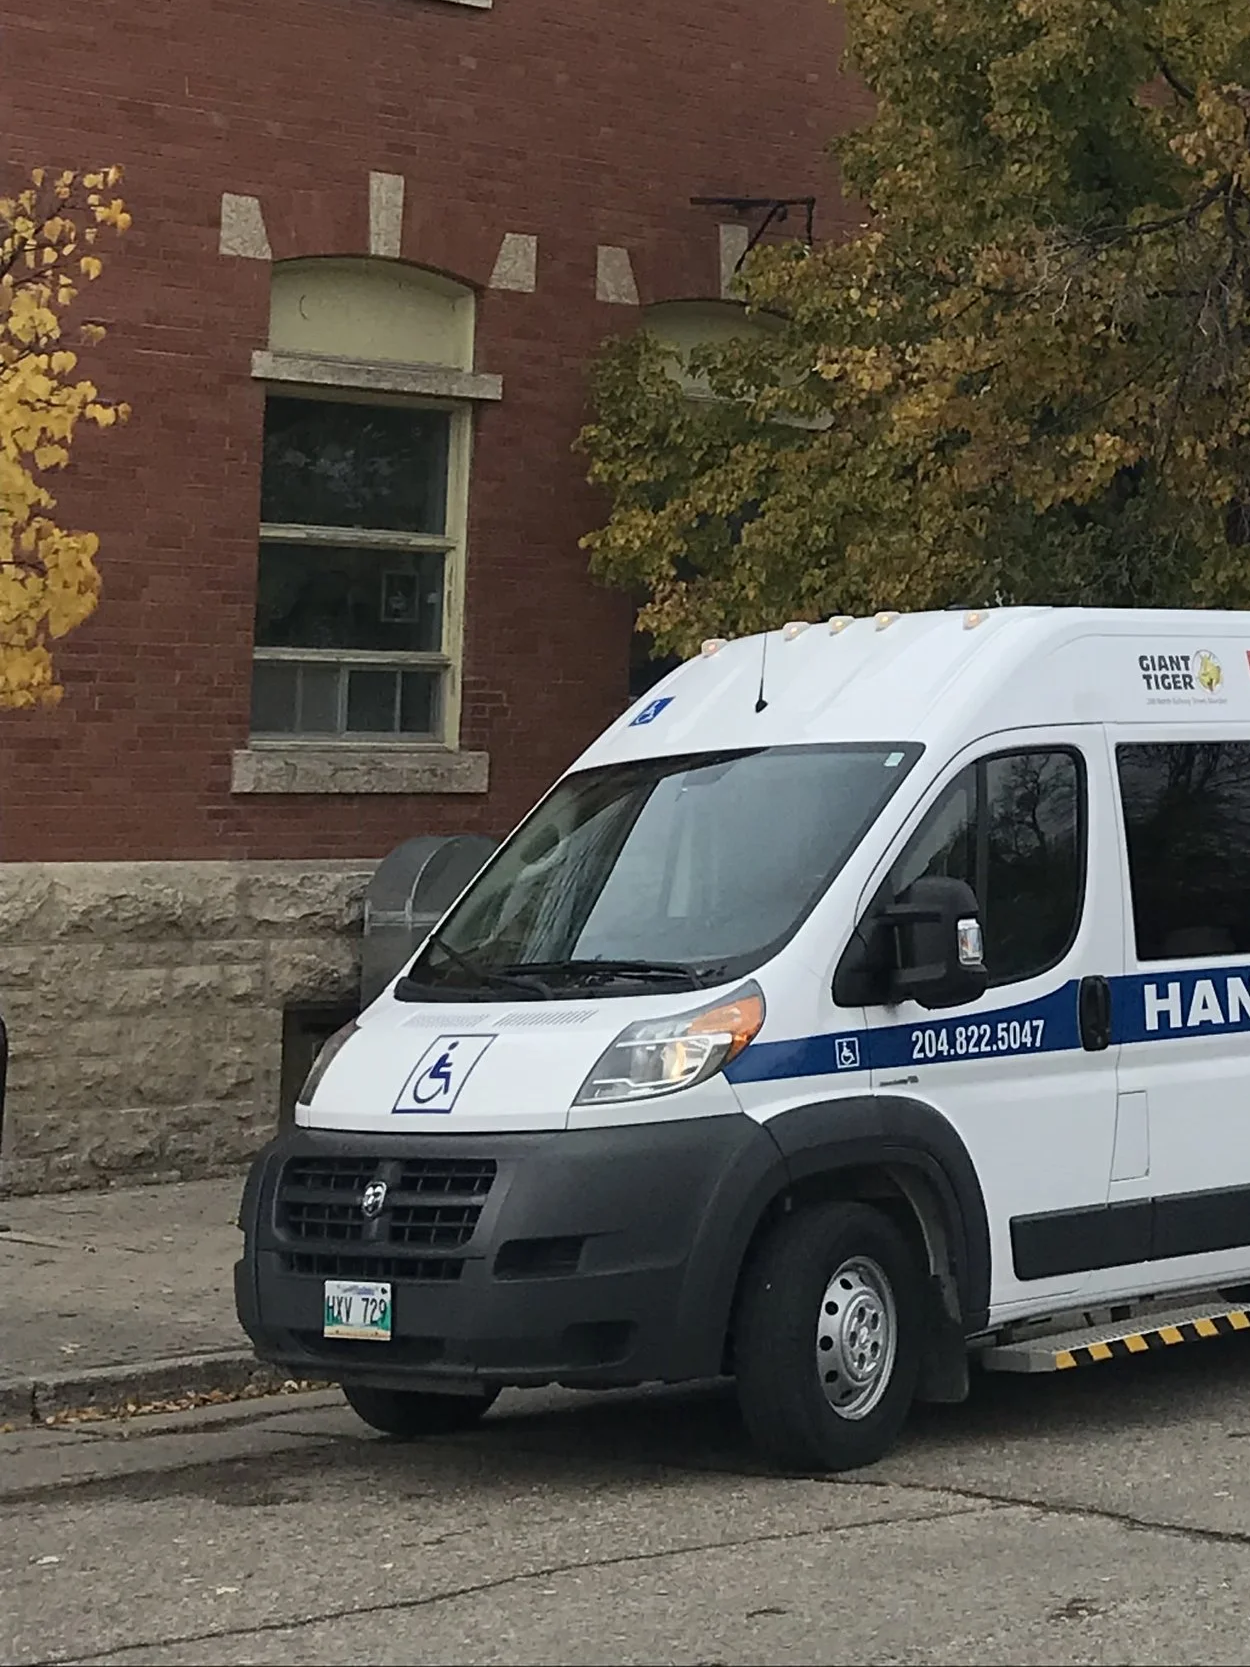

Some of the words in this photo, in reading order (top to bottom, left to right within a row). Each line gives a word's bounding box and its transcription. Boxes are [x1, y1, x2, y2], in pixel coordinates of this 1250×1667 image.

[1138, 654, 1191, 671] GIANT
[1142, 674, 1195, 691] TIGER
[911, 1019, 1045, 1060] 204.822.5047
[326, 1295, 353, 1323] HXV
[361, 1297, 388, 1325] 729
